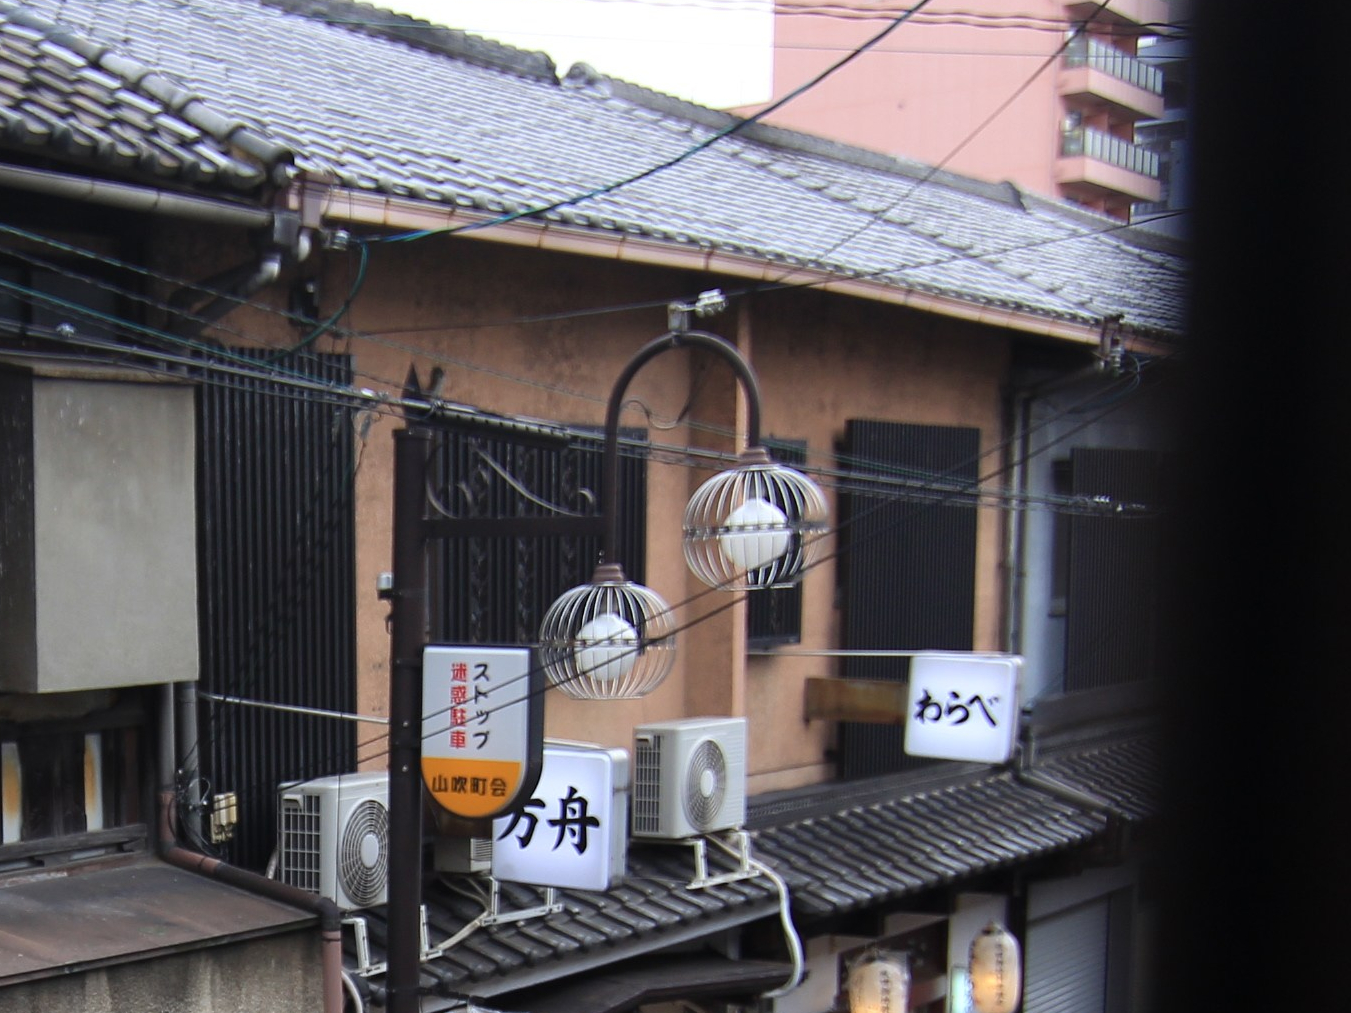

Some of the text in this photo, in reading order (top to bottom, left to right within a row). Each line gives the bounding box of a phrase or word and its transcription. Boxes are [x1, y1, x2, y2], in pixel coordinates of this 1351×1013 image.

[450, 662, 468, 750] 迷惑駐車
[473, 662, 491, 750] ストップ
[913, 687, 1000, 728] わらべ
[431, 774, 508, 797] 山吹町会
[496, 785, 601, 856] 方舟
